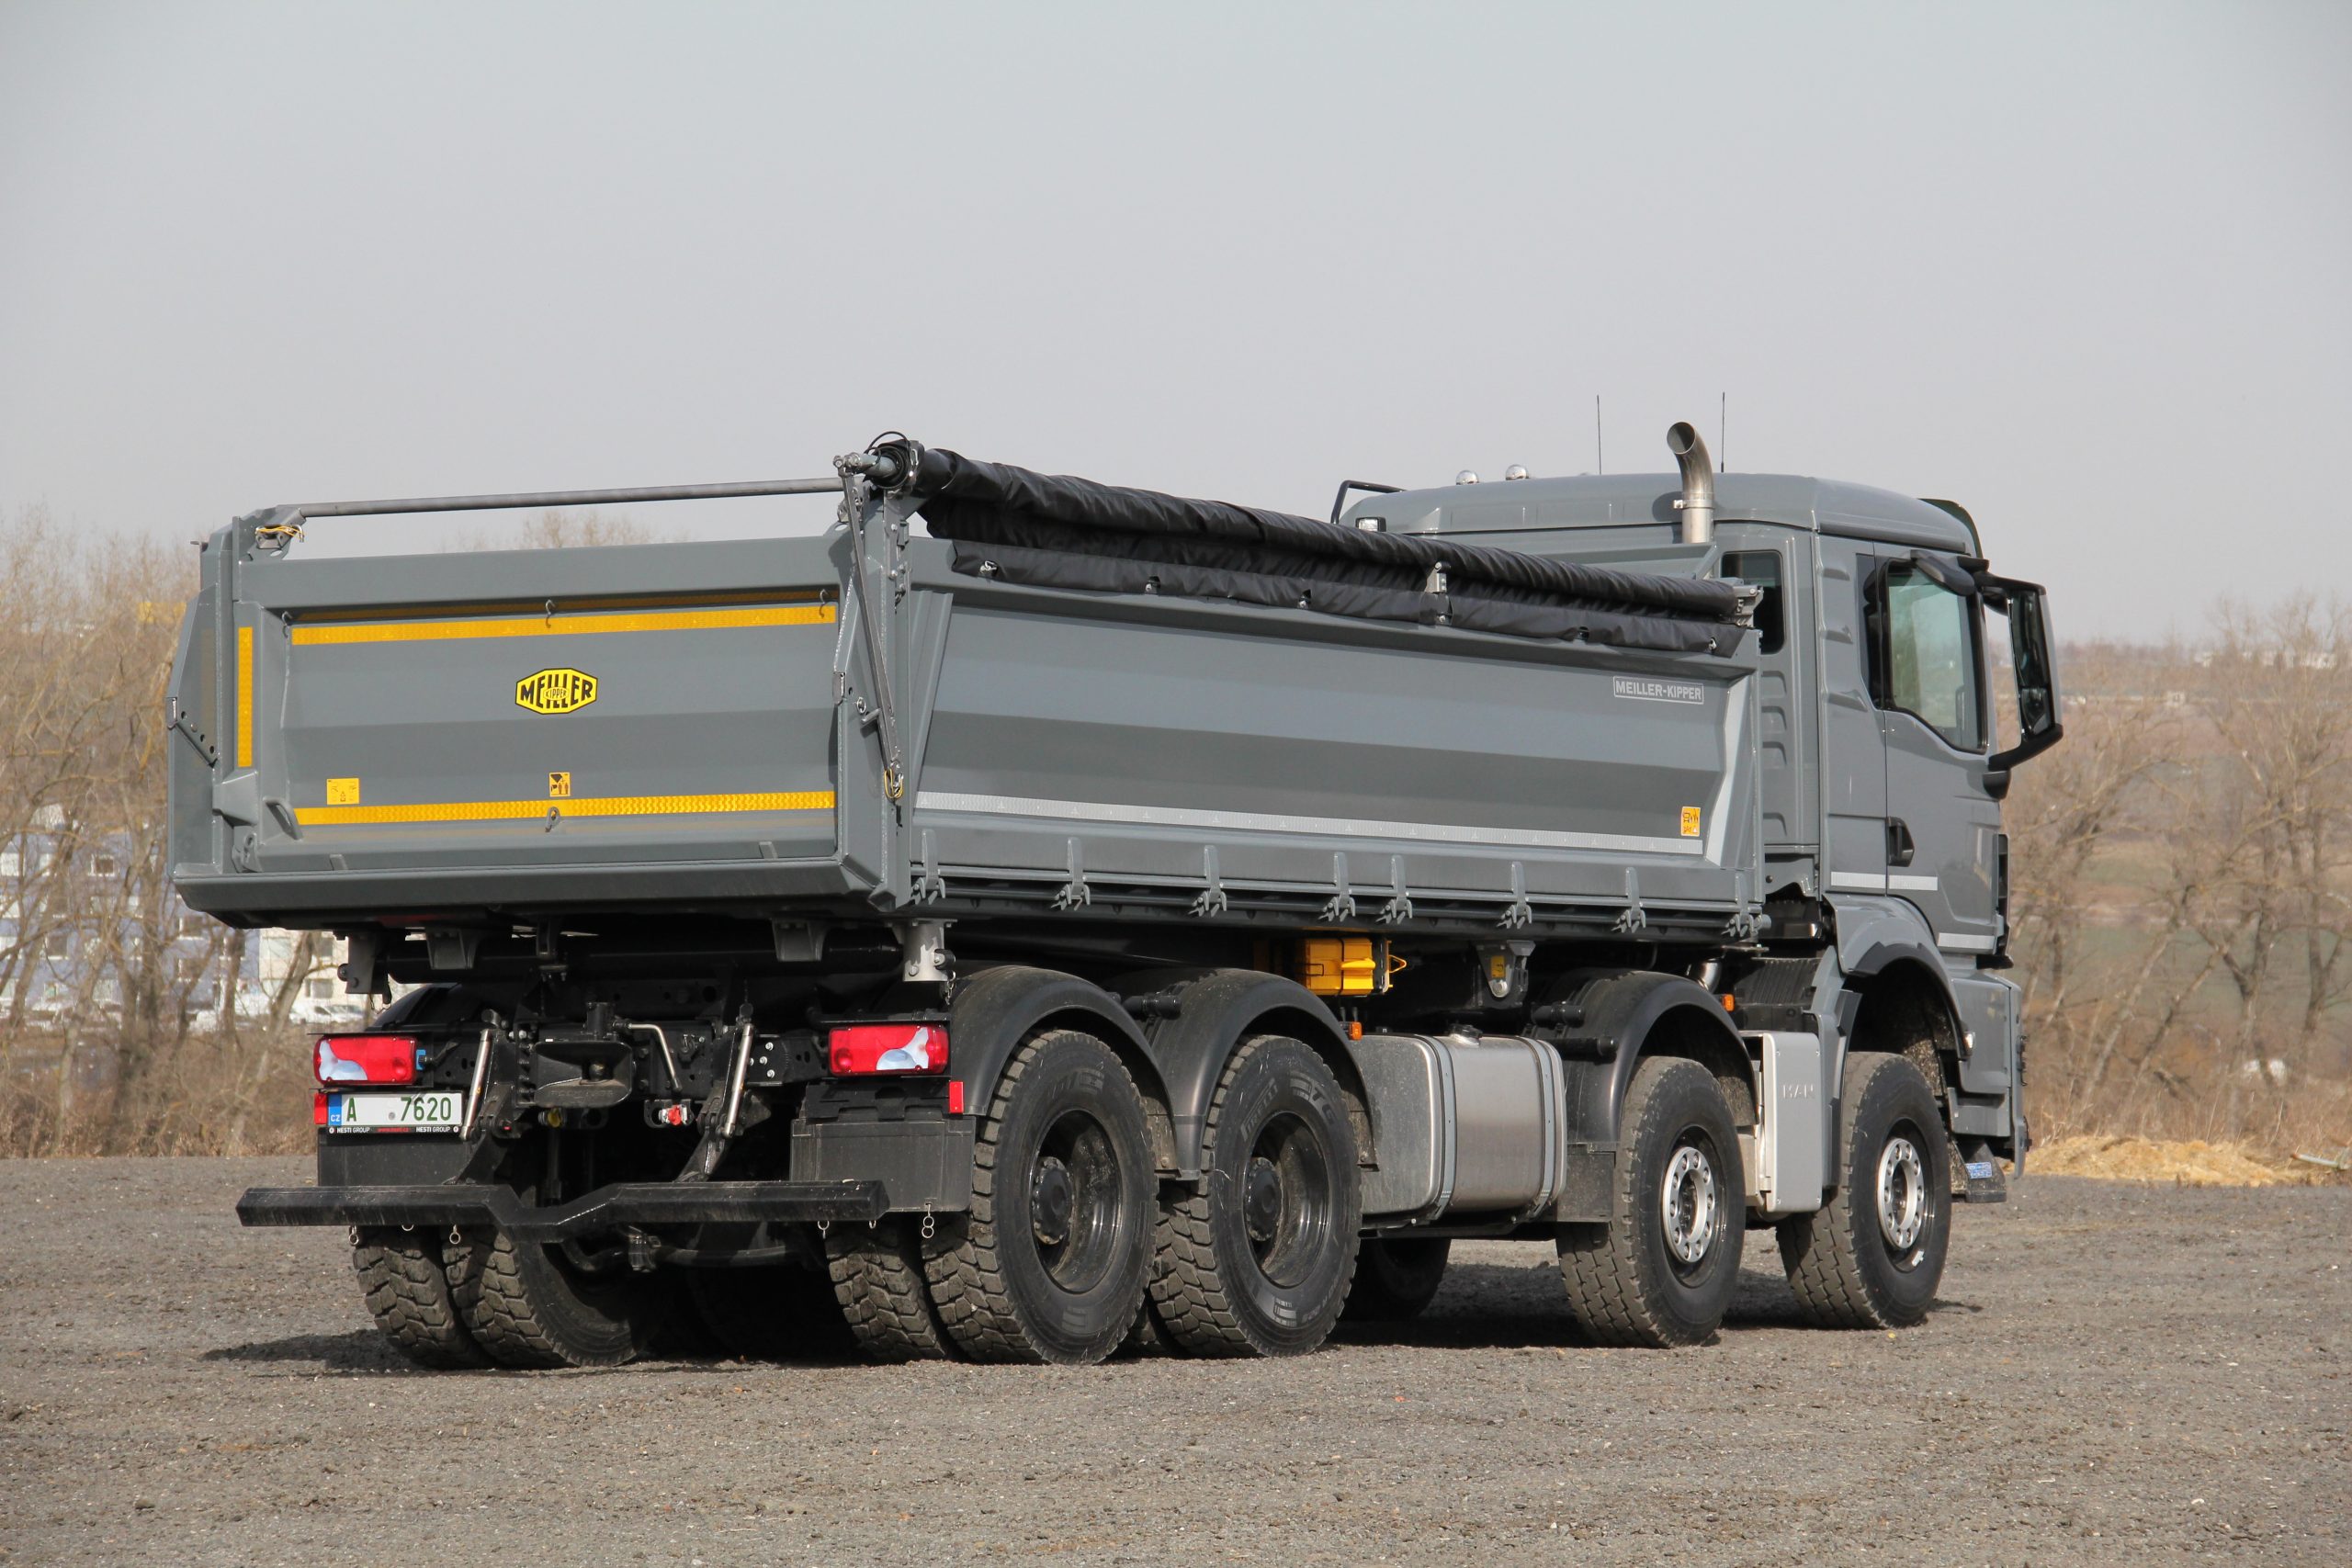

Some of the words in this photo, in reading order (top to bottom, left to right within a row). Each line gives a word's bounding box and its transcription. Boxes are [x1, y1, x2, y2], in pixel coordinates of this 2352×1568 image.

[520, 673, 594, 709] MEILLER
[545, 688, 567, 699] KIPPER
[1615, 680, 1702, 700] MEILLER-KIPPER
[330, 1114, 341, 1122] CZ
[346, 1097, 357, 1122] A
[401, 1097, 452, 1122] 7620
